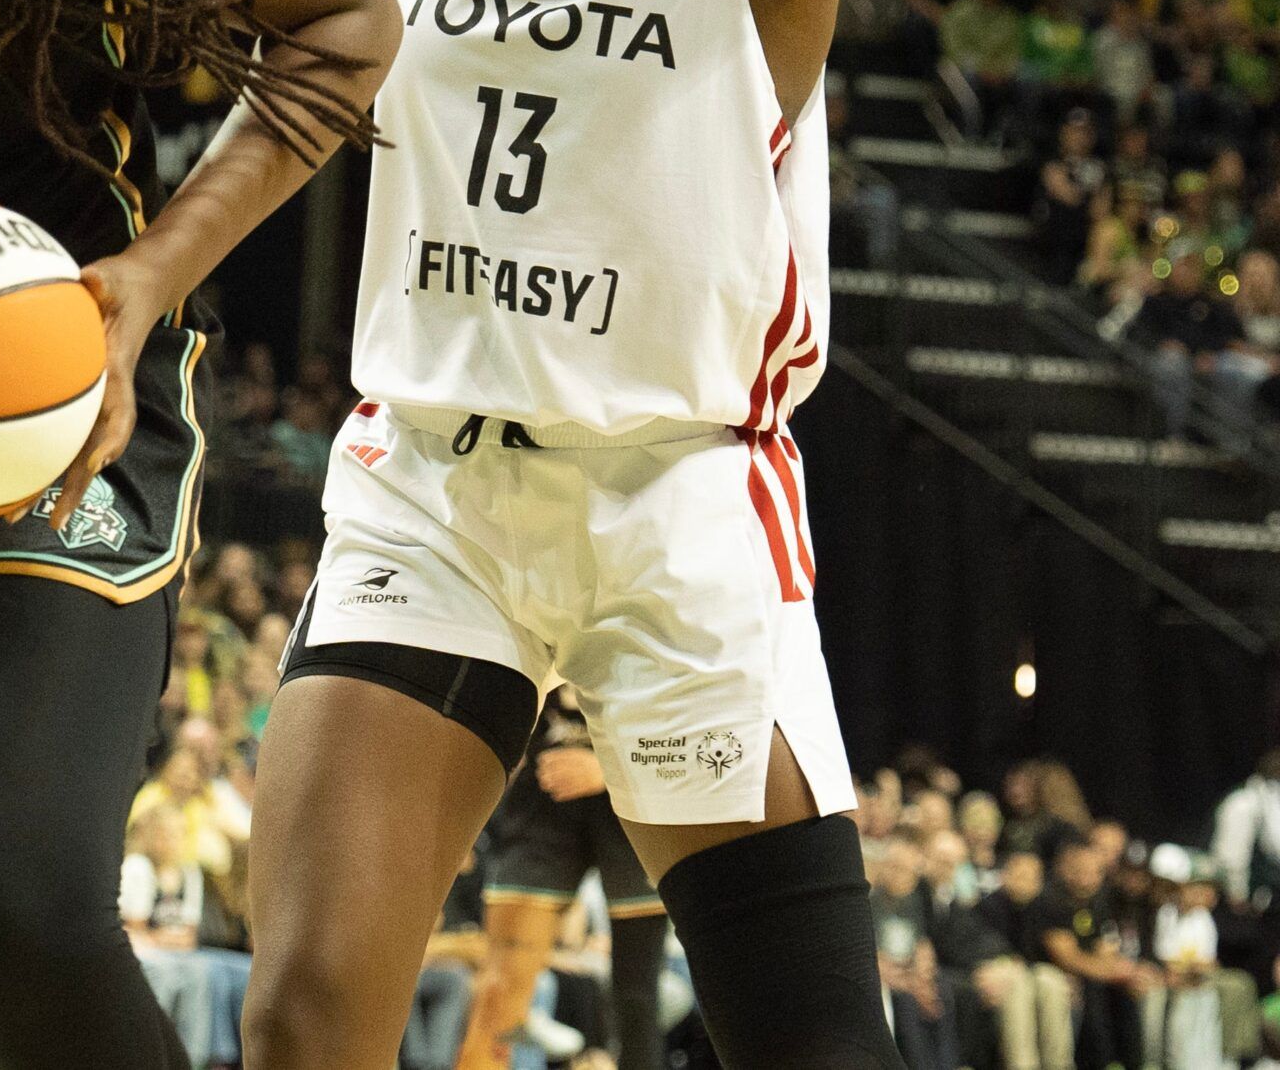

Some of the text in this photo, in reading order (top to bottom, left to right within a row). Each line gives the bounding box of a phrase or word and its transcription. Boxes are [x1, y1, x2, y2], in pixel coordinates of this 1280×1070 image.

[466, 85, 558, 215] 13
[338, 593, 409, 606] ANTELOPES
[638, 736, 687, 750] Special
[631, 752, 687, 766] Olympics
[656, 768, 687, 780] Nippon
